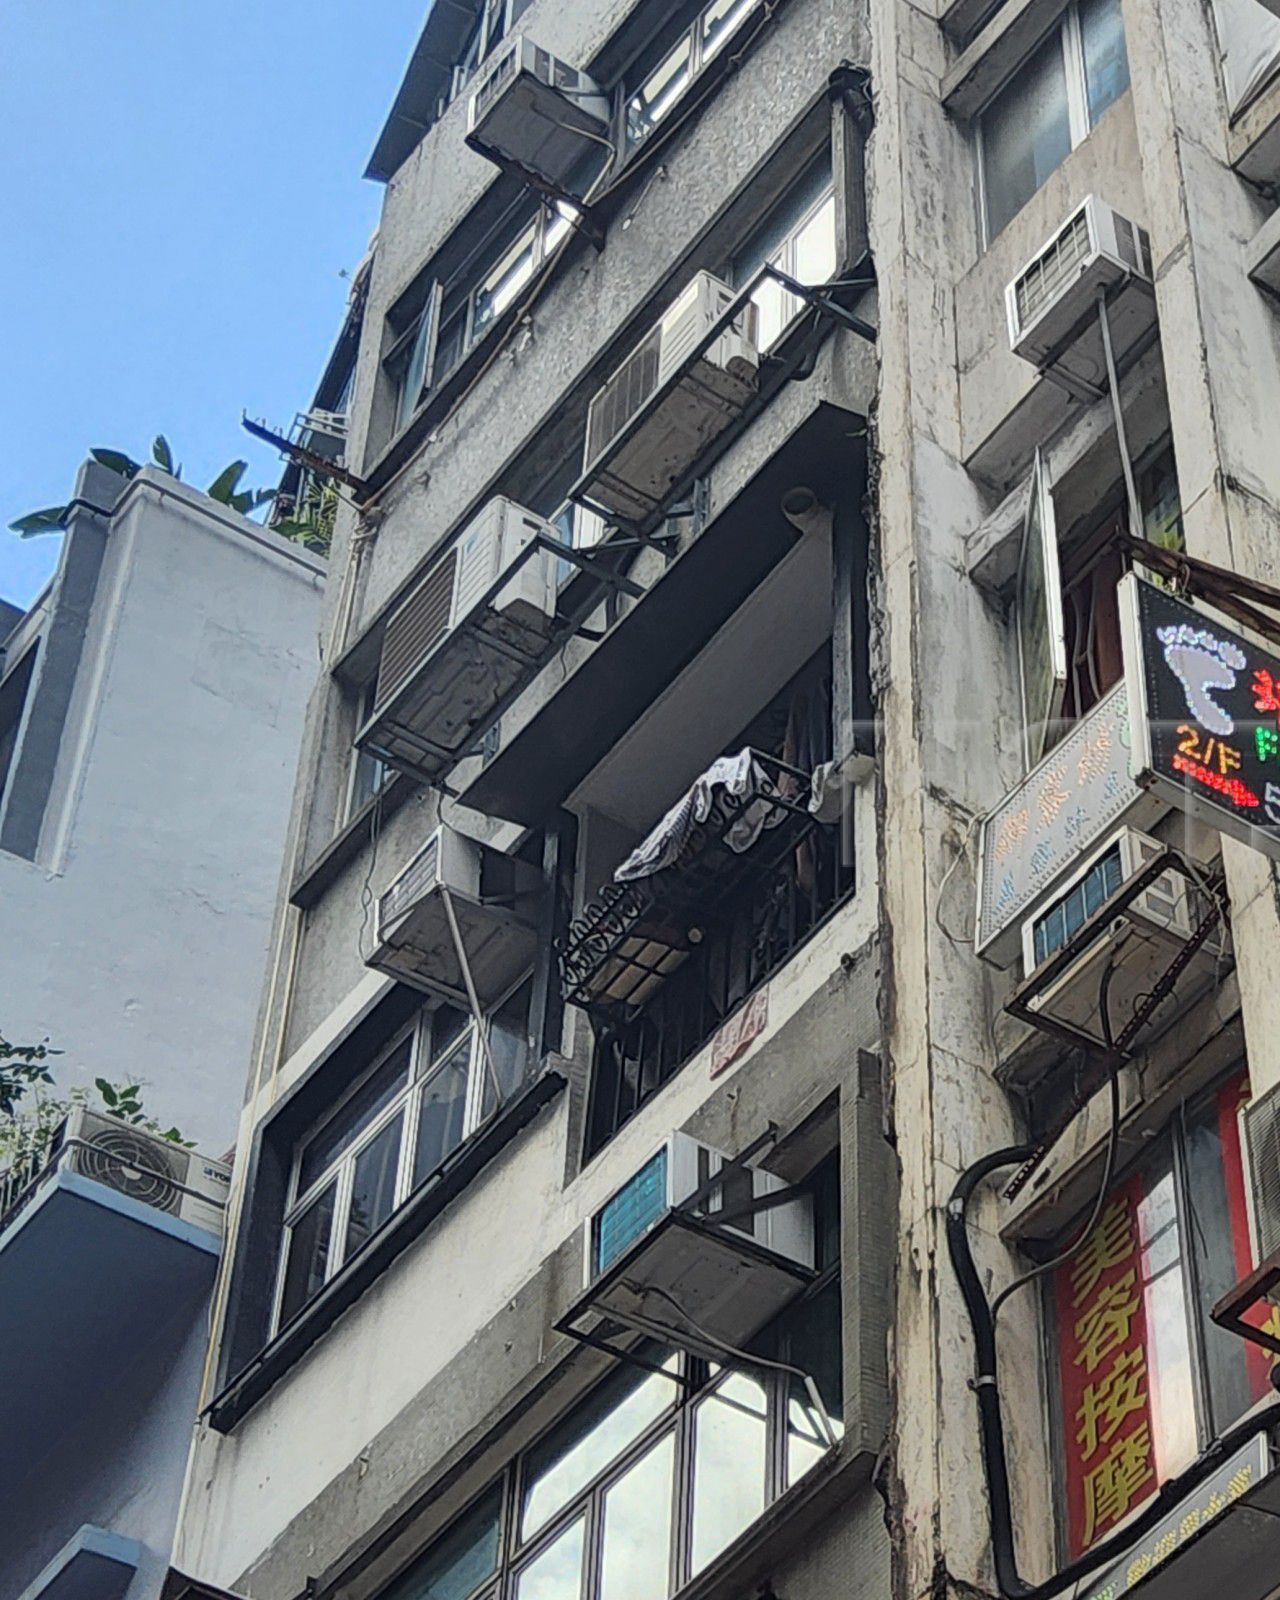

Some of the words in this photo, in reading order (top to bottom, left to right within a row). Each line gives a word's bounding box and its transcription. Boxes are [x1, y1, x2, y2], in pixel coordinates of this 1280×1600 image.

[1176, 724, 1242, 775] 2/F
[1071, 1197, 1156, 1547] 美容按摩
